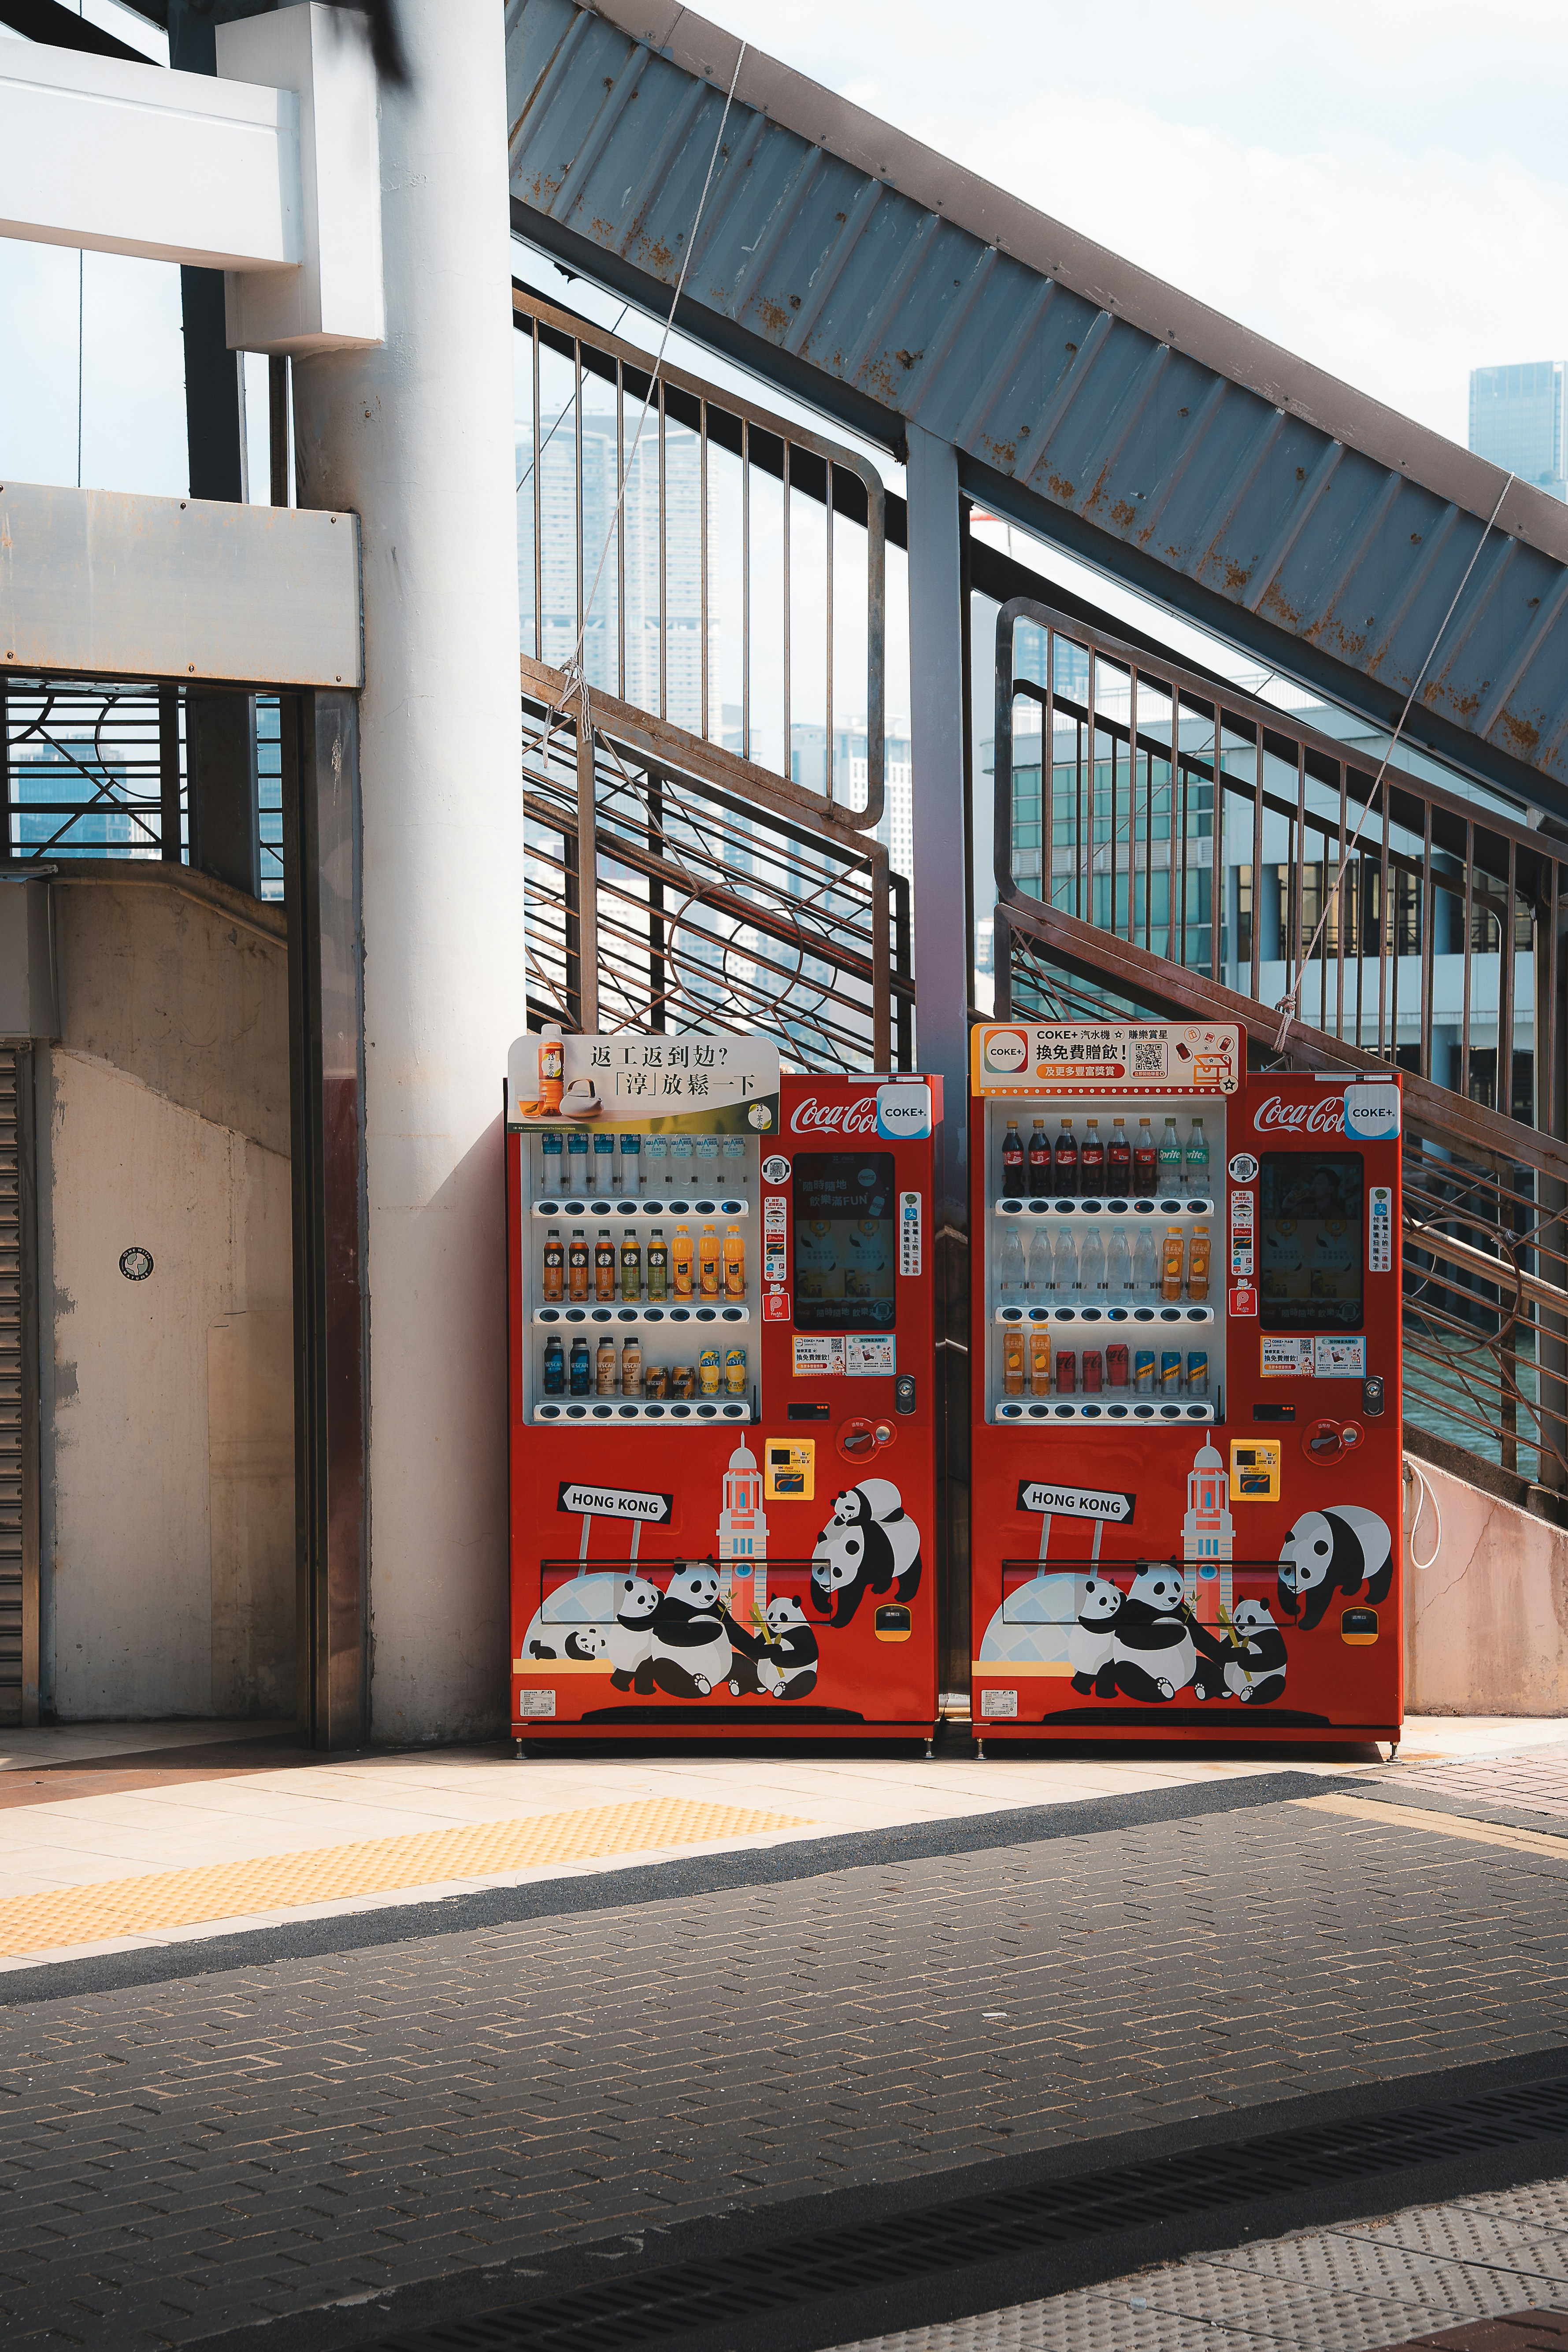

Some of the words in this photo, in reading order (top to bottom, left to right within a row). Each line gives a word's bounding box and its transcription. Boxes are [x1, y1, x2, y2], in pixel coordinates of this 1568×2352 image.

[1037, 1030, 1078, 1039] COKE+
[1081, 1030, 1110, 1040] 汽水機
[1128, 1030, 1168, 1039] 賺樂賞星
[1036, 1045, 1126, 1060] 換免費贈飲!
[1045, 1066, 1115, 1076] 及更多豐富獎賞
[617, 1072, 755, 1096] 「淳」放鬆一下
[790, 1097, 878, 1133] Coca-Col
[1254, 1096, 1345, 1132] Coca-Col
[1160, 1150, 1179, 1160] Sprite
[803, 1179, 846, 1191] 隨時隨地
[123, 1248, 135, 1257] ONE
[138, 1248, 150, 1259] WITH
[123, 1270, 148, 1280] NATURE
[817, 1307, 849, 1317] 隨時隨地
[572, 1493, 614, 1508] HONG
[618, 1498, 659, 1514] KONG
[1032, 1491, 1075, 1508] HONG
[1079, 1497, 1120, 1514] KONG
